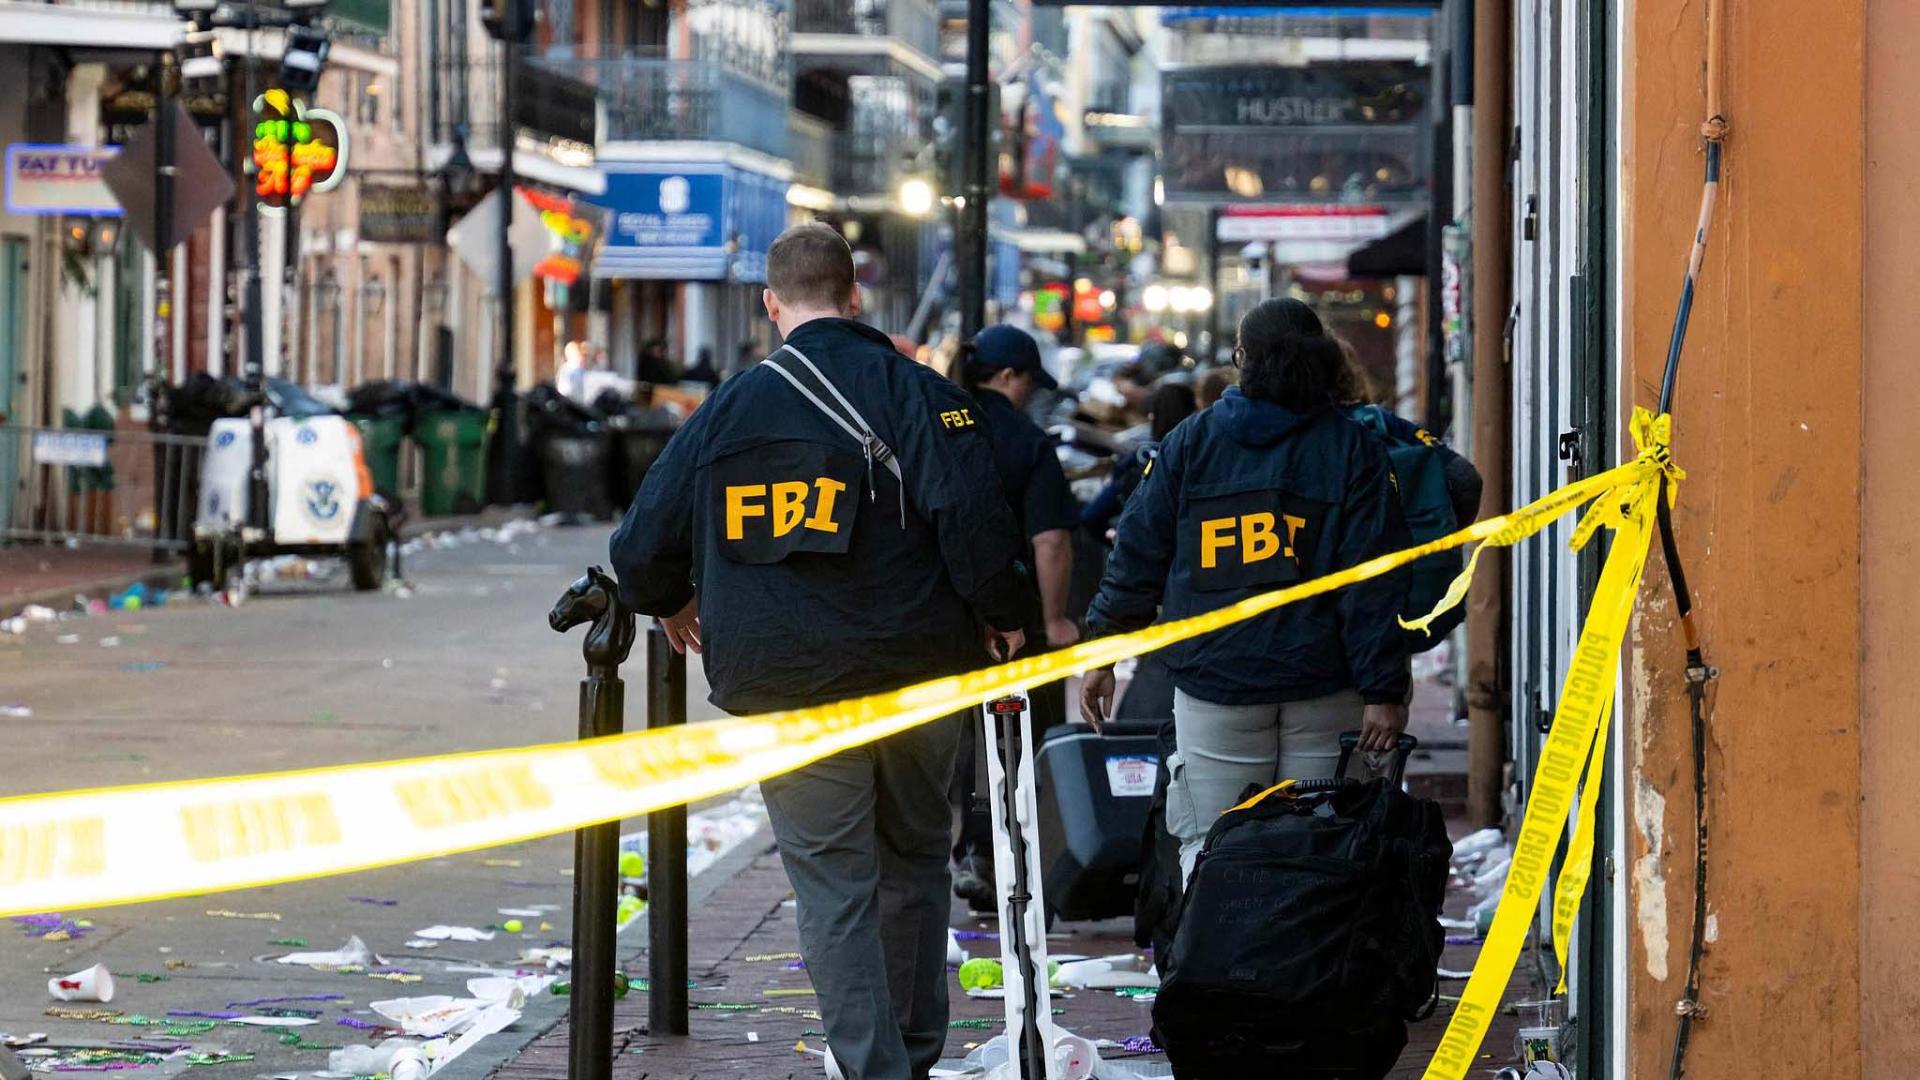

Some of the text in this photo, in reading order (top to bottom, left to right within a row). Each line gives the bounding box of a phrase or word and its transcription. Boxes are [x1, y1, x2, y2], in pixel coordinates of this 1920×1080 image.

[1237, 97, 1346, 121] HUSTLER
[18, 156, 59, 171] FAT
[940, 408, 975, 429] FBI
[725, 477, 847, 540] FBI
[1201, 512, 1306, 569] FBI
